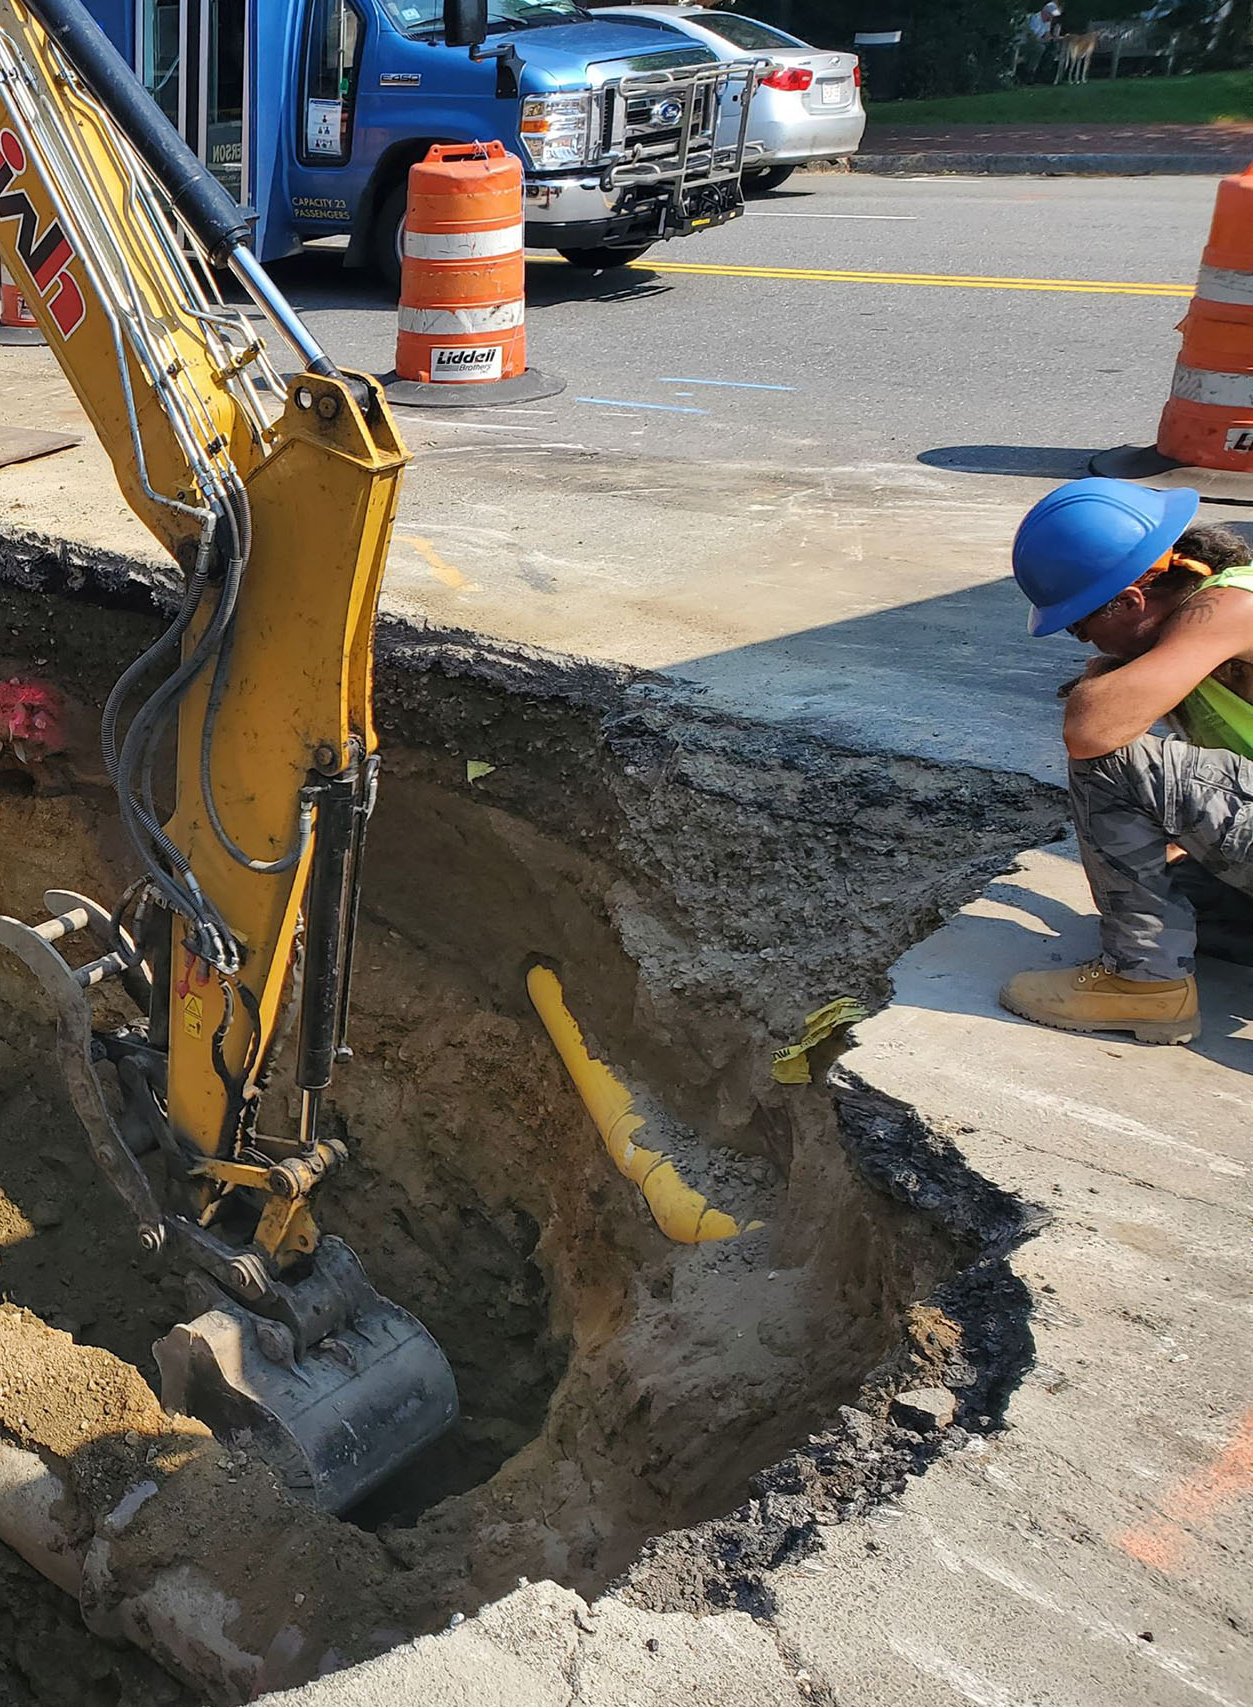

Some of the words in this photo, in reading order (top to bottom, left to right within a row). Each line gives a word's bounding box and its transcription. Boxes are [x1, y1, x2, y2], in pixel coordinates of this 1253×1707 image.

[291, 197, 333, 209] CAPACITY
[335, 199, 347, 209] 23
[294, 208, 351, 220] PASSENGERS
[436, 349, 497, 365] Liddell
[458, 363, 493, 373] Brothers
